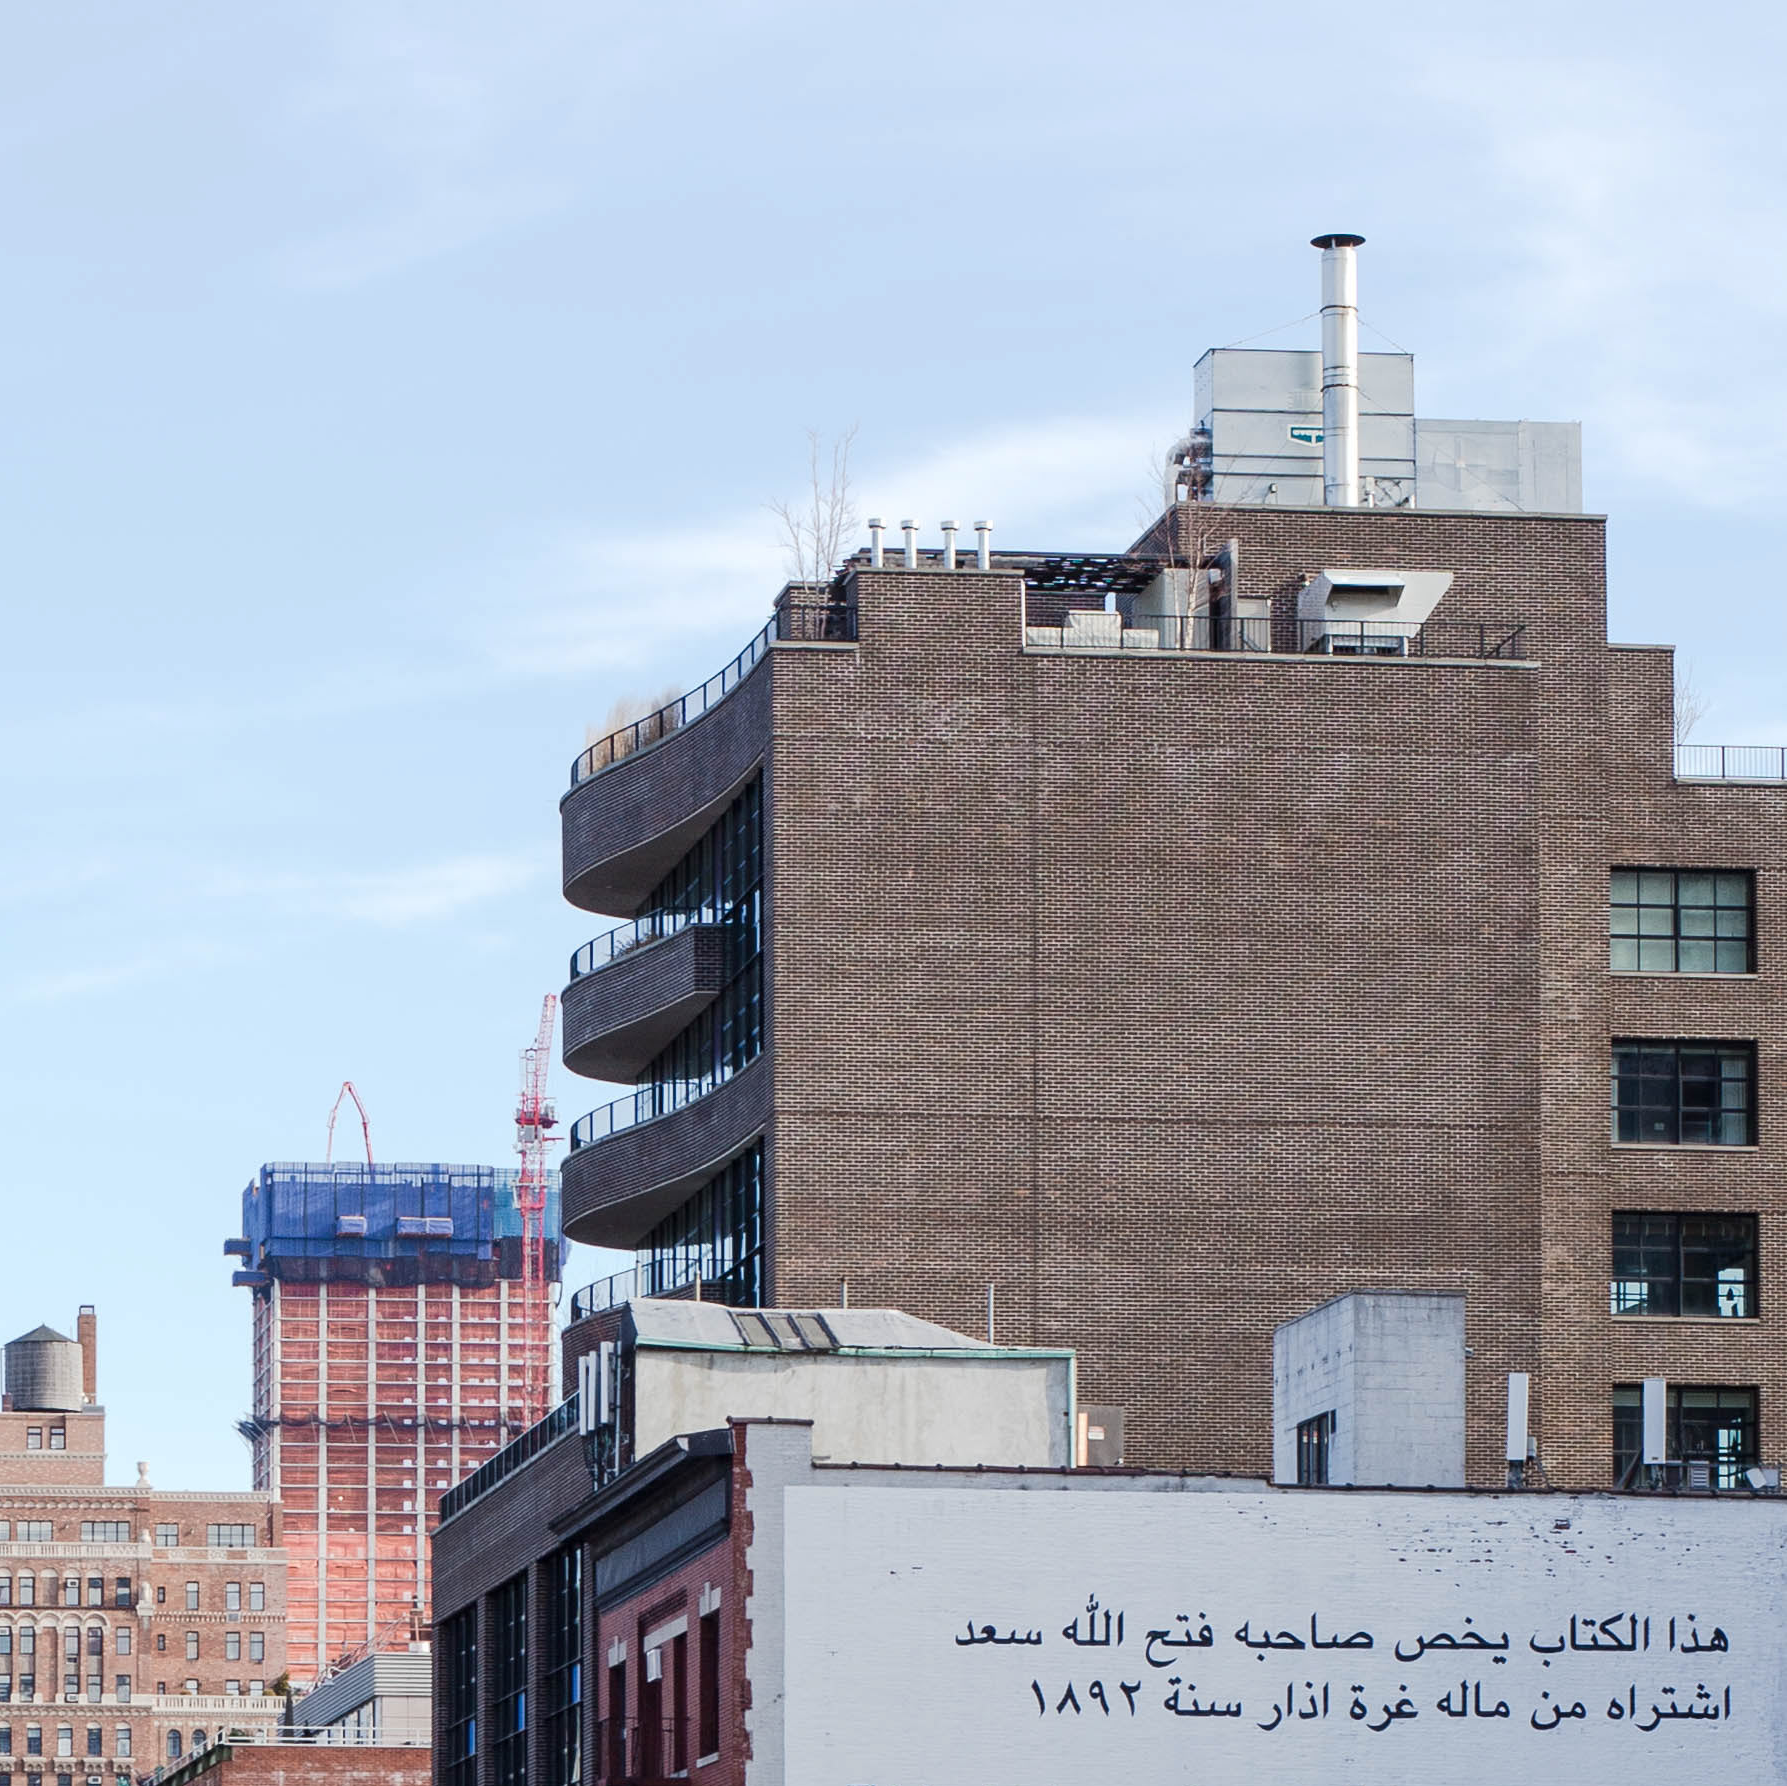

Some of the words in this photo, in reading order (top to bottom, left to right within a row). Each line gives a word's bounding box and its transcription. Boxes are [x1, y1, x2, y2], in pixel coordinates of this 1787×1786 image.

[955, 1620, 1043, 1646] سعد
[1145, 1611, 1214, 1667] فتح
[1234, 1612, 1374, 1661] صاحبه
[1394, 1616, 1510, 1664] يخص
[1529, 1613, 1650, 1667] الكتاب
[1669, 1614, 1729, 1653] هذا
[1031, 1679, 1141, 1716] ١٨٩٢
[1163, 1676, 1242, 1717] سنة
[1257, 1682, 1329, 1731] اذار
[1349, 1684, 1419, 1731] غرة
[1436, 1680, 1511, 1718] ماله
[1530, 1691, 1587, 1731] من
[1606, 1683, 1731, 1732] اشتراه
